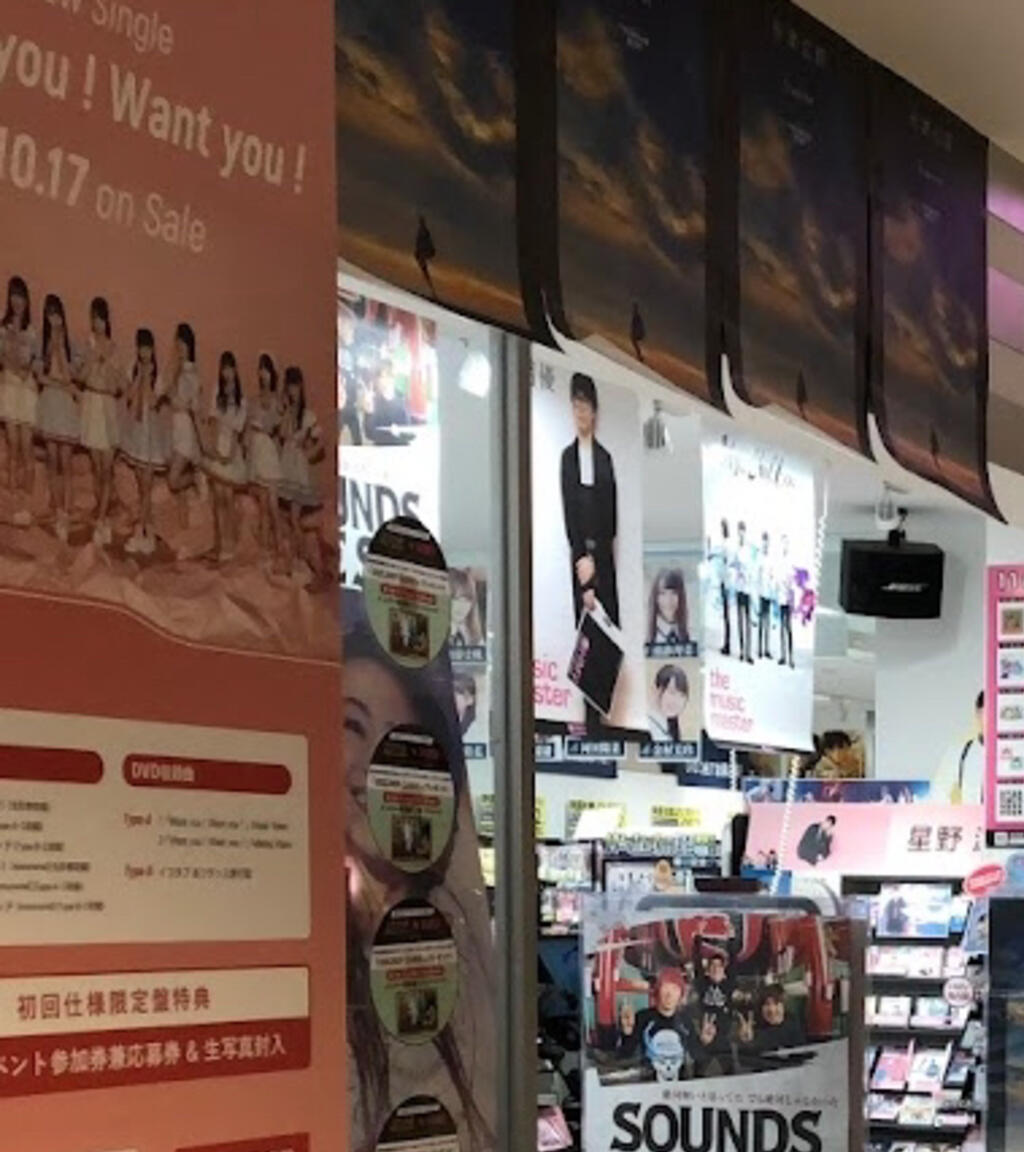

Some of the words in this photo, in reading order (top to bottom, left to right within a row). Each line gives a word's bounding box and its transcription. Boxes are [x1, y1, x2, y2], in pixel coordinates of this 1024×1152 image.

[110, 64, 212, 158] Want
[96, 184, 134, 226] on
[144, 193, 206, 252] Sale
[710, 668, 730, 690] the
[711, 693, 745, 712] music
[17, 986, 211, 1021] 初回仕様限定盤特典
